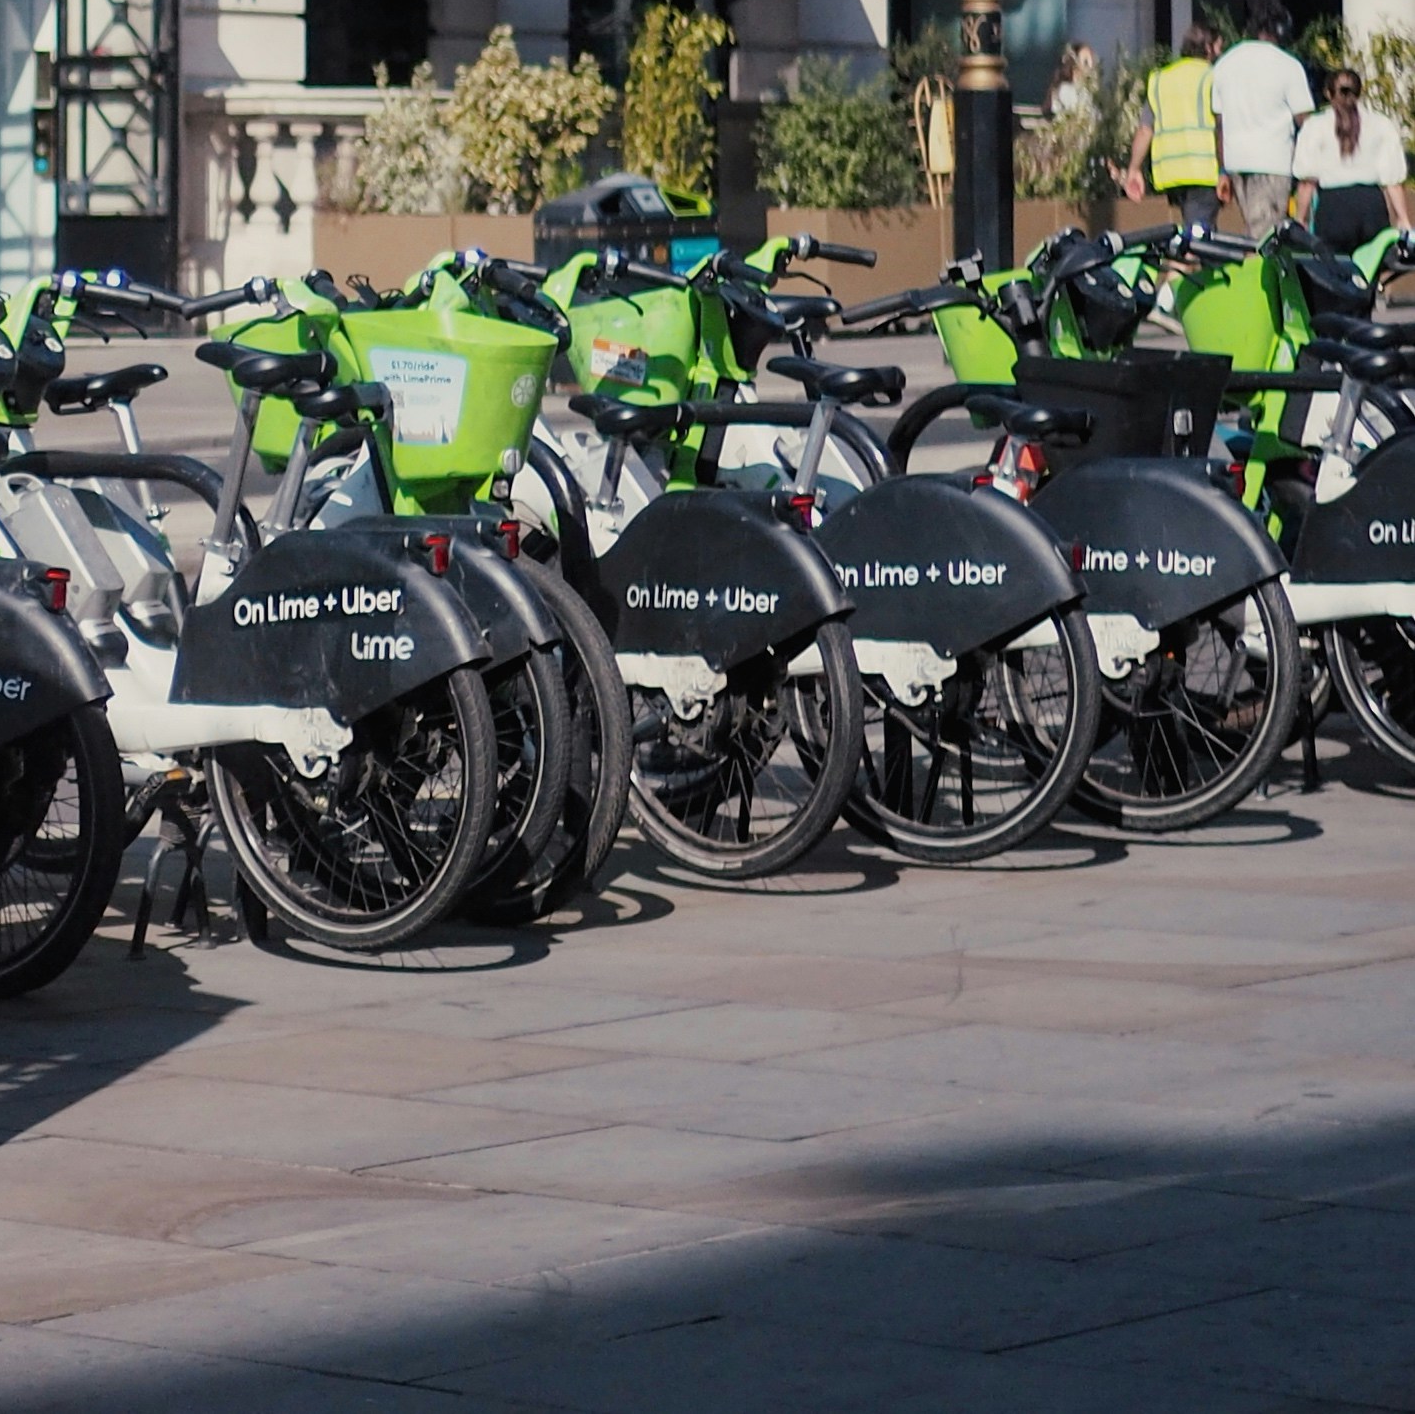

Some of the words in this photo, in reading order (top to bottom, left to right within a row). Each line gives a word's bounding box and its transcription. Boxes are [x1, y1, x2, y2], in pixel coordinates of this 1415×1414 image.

[1369, 519, 1397, 545] On
[864, 558, 920, 587] Lime
[926, 562, 941, 583] +
[948, 558, 1007, 586] Uber
[1082, 544, 1129, 572] ime
[1136, 549, 1151, 570] +
[1157, 548, 1217, 577] Uber
[233, 597, 265, 627] On
[267, 592, 320, 622] Lime
[323, 592, 337, 612] +
[341, 585, 402, 616] Uber
[626, 583, 650, 609] On
[653, 582, 700, 610] Lime
[705, 587, 718, 608] +
[724, 585, 779, 614] Uber
[351, 630, 415, 661] Lime
